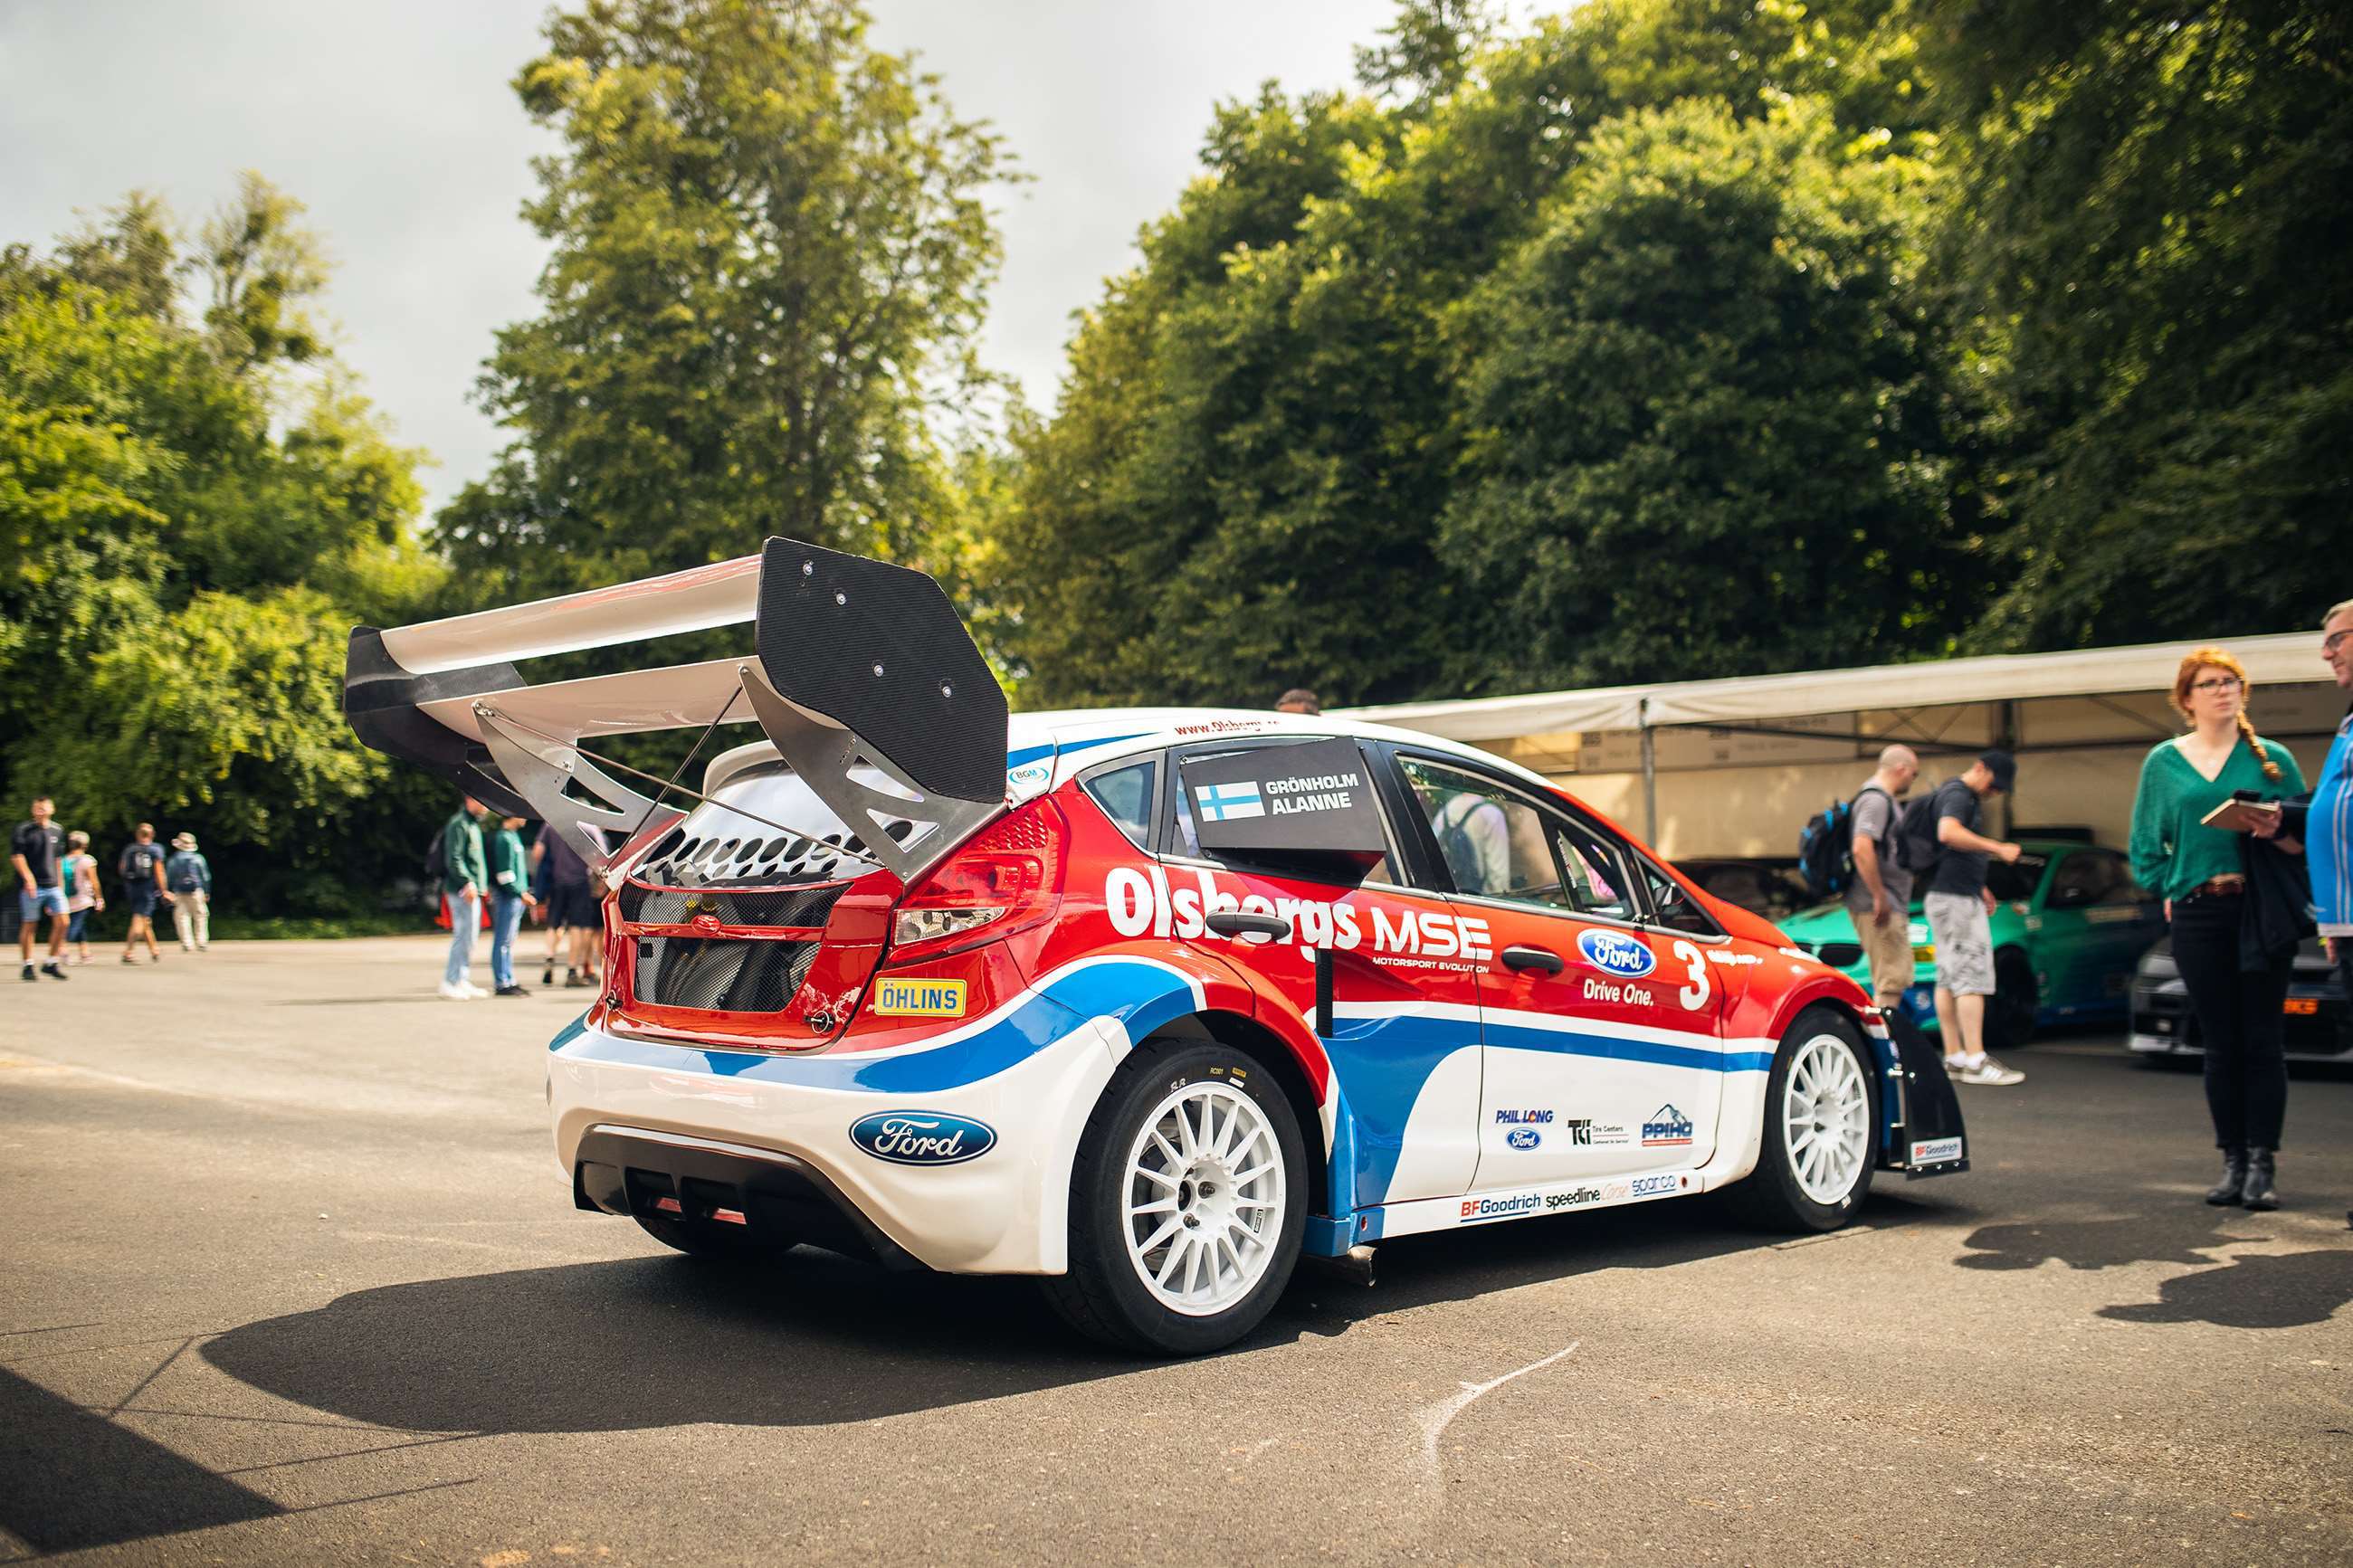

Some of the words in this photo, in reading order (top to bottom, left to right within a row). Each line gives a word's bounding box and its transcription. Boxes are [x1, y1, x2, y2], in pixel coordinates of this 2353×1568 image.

[1265, 773, 1359, 794] GRÖNHOLM
[1272, 792, 1352, 815] ALANNE
[1370, 906, 1493, 961] MSE
[1372, 956, 1437, 969] MOTORSPORT
[1439, 962, 1490, 974] EVOLUTON
[1593, 934, 1644, 971] Ford
[1672, 940, 1711, 1012] 3
[882, 983, 958, 1010] ÖHLINS
[1583, 978, 1620, 1001] Drive
[1623, 984, 1655, 1007] One.
[1495, 1109, 1519, 1124] PHIL
[1522, 1109, 1554, 1124] LONG
[874, 1118, 965, 1157] Ford
[1510, 1130, 1537, 1147] Ford
[1461, 1193, 1541, 1217] BFGoodrich
[1546, 1187, 1601, 1211] speedline
[1632, 1174, 1676, 1195] sparco
